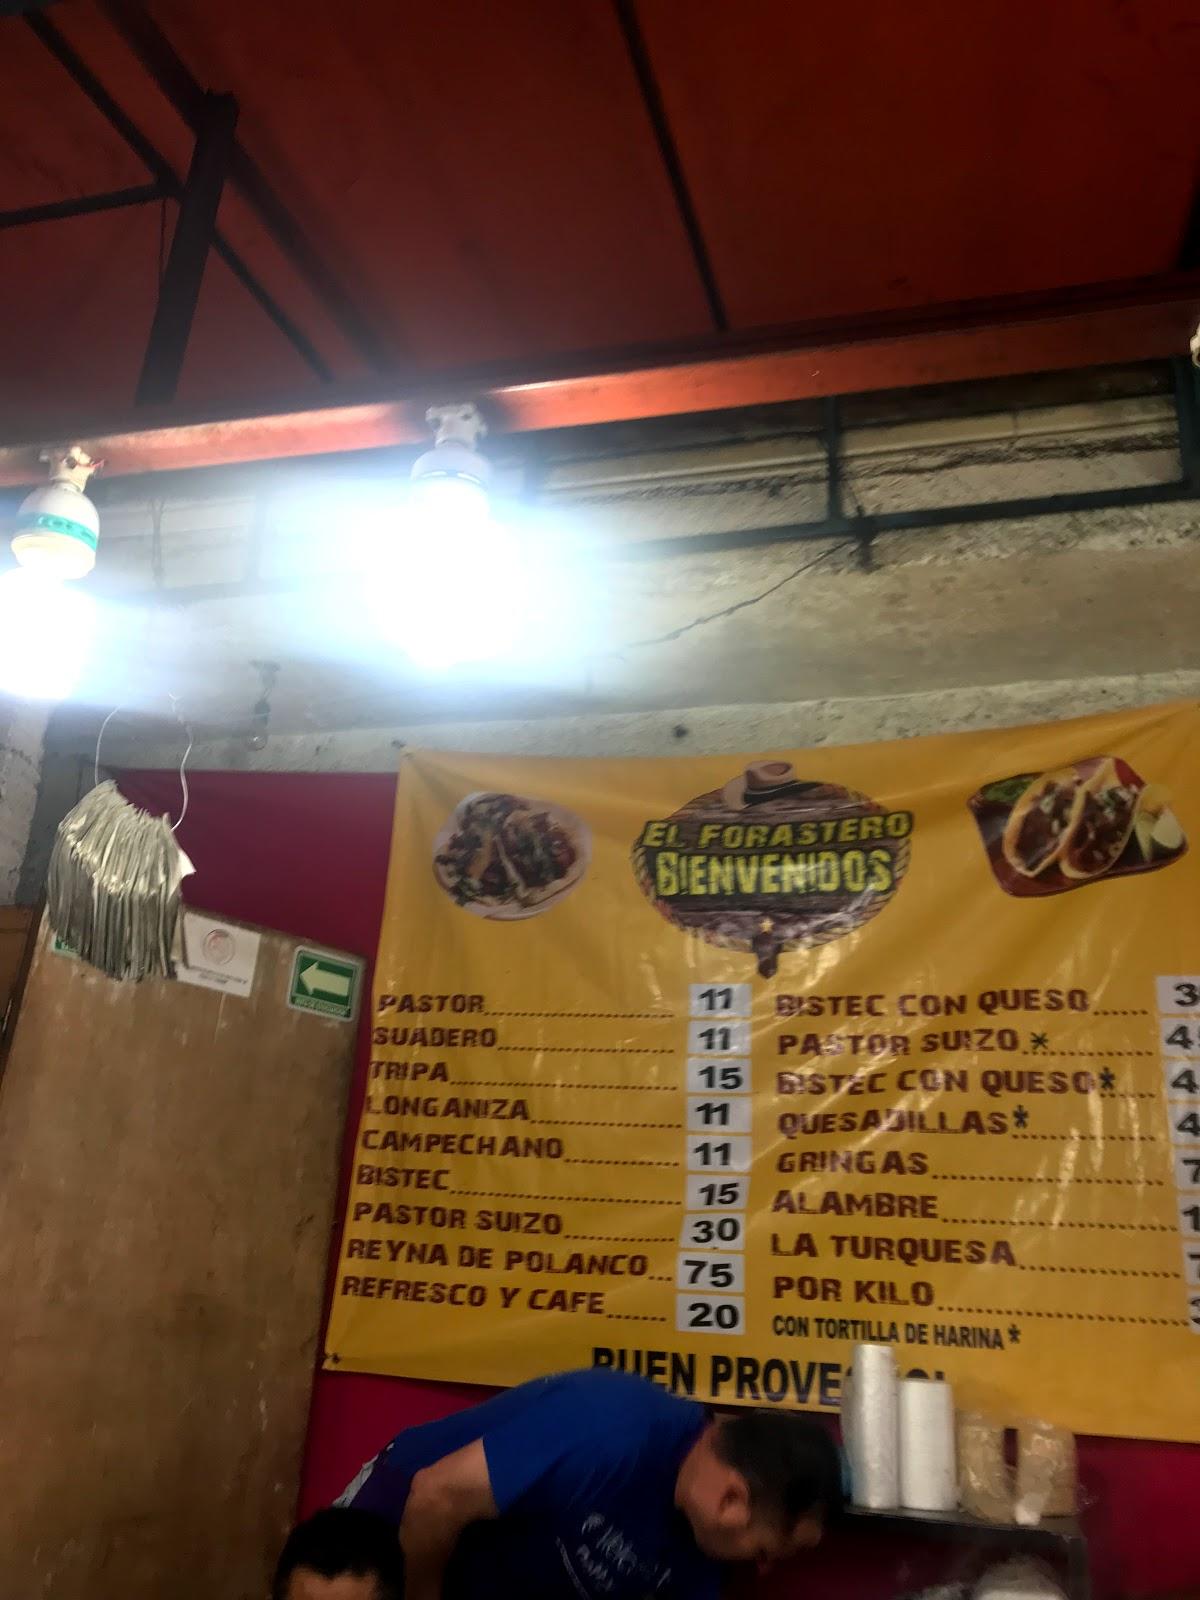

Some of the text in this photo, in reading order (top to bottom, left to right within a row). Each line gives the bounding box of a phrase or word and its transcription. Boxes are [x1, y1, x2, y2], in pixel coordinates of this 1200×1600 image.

[641, 811, 913, 850] EL FORASTERO
[655, 849, 894, 896] BIENVENIDOS
[379, 993, 485, 1015] PASTOR
[700, 987, 733, 1011] 11
[776, 988, 1089, 1017] BISTEC CON QUESO
[1174, 983, 1200, 1007] 3
[374, 1026, 498, 1047] SUADERO
[698, 1027, 731, 1051] 11
[777, 1028, 1019, 1056] PASTOR SUIZO
[1166, 1025, 1200, 1049] 4
[369, 1061, 450, 1083] TRIPA
[698, 1065, 744, 1090] 15
[776, 1072, 887, 1096] BISTEC
[897, 1069, 969, 1094] CON
[367, 1095, 531, 1121] LONGANIZA
[695, 1103, 729, 1126] 11
[361, 1130, 565, 1160] CAMPECHANO
[693, 1142, 732, 1166] 11
[356, 1164, 452, 1191] BISTEC
[777, 1151, 929, 1177] GRINGAS
[699, 1182, 740, 1206] 15
[772, 1190, 939, 1220] ALAMBRE
[352, 1202, 563, 1236] PASTOR SUIZO
[692, 1218, 741, 1244] 30
[346, 1239, 648, 1277] REYNA DE POLANCO
[771, 1233, 1018, 1267] LA TURQUESA
[683, 1260, 734, 1289] 75
[341, 1275, 606, 1315] REFRESCO Y CAFE
[772, 1276, 936, 1307] POR KILO
[688, 1302, 741, 1330] 20
[772, 1315, 810, 1338] CON
[814, 1318, 900, 1344] TORTILLA
[905, 1322, 930, 1345] DE
